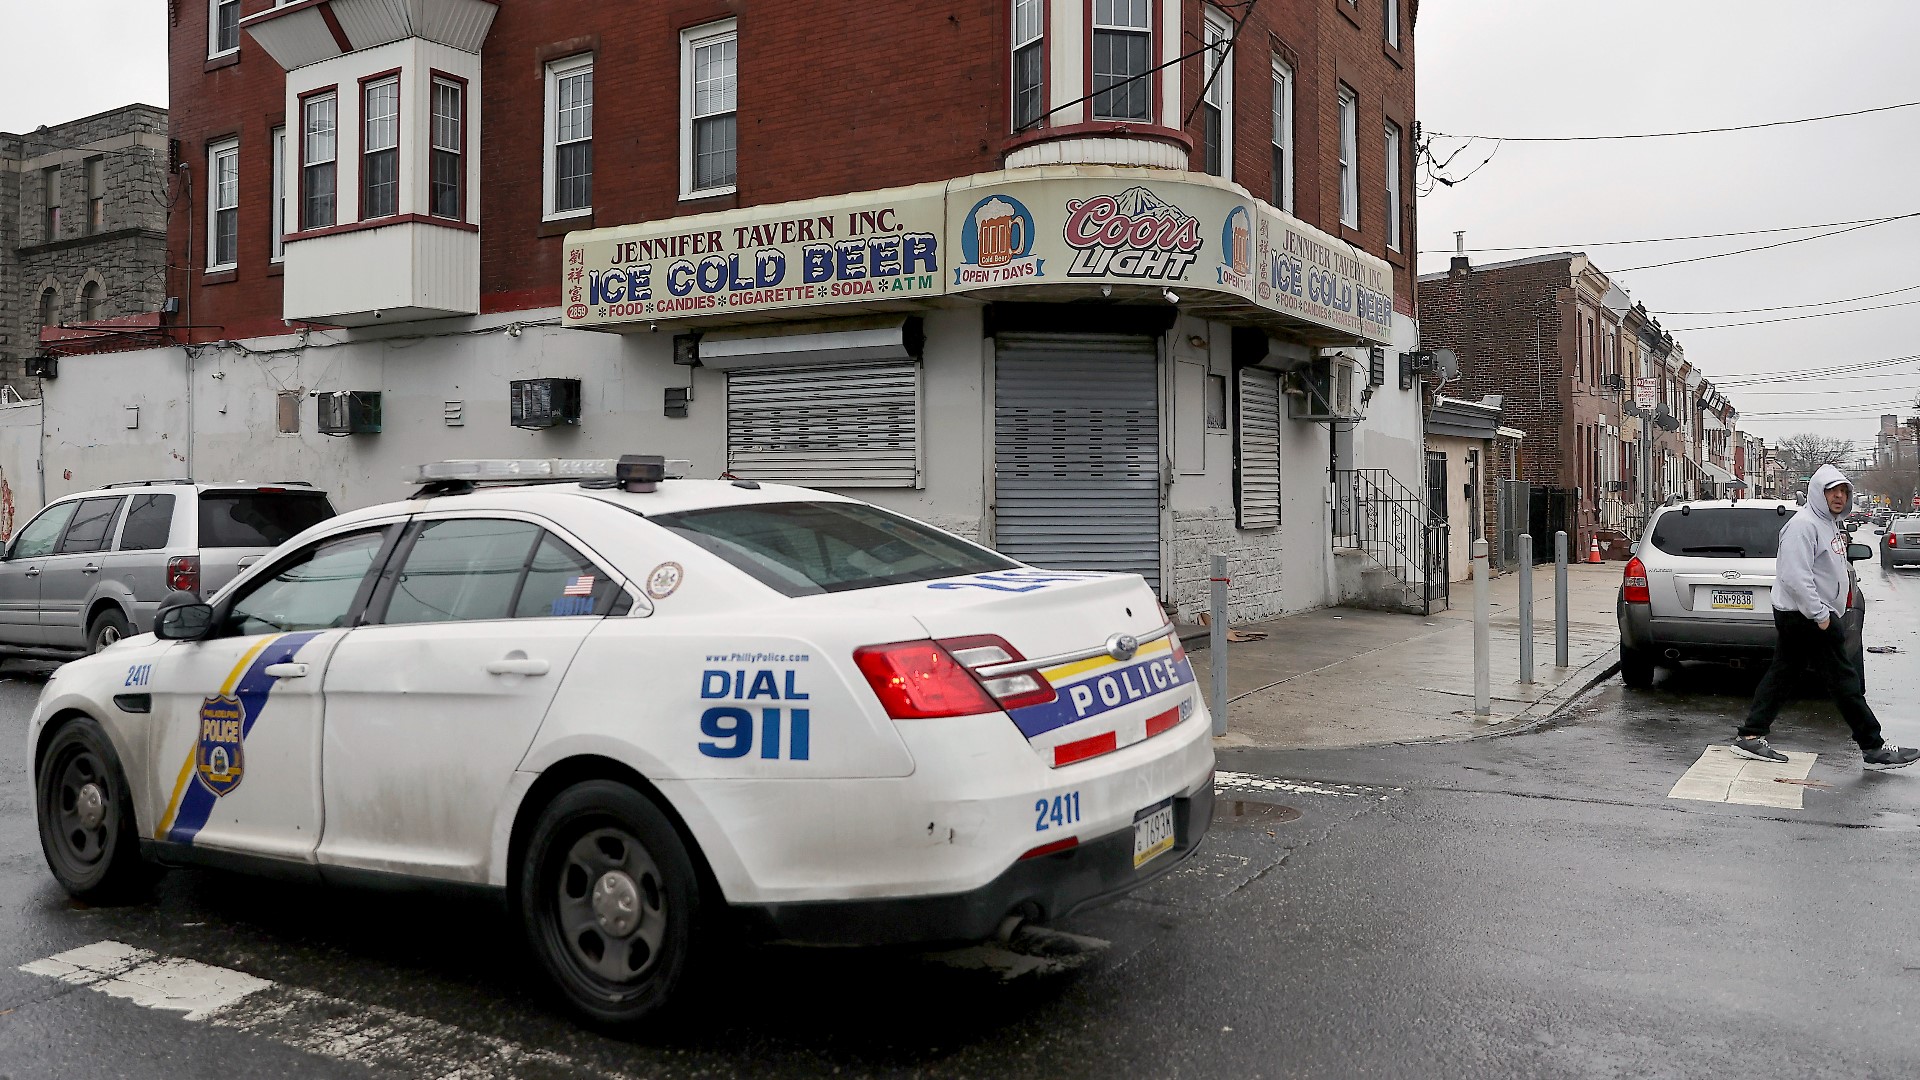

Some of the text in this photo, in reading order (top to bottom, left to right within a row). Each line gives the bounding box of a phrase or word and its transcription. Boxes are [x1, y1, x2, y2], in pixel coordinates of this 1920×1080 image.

[611, 208, 904, 265] JENNIFER TAVERN INC.
[1063, 195, 1204, 253] Coors
[981, 254, 1008, 264] Cold Beer
[1067, 248, 1198, 280] LIGHT
[1283, 229, 1331, 270] JENNIFER
[588, 231, 938, 306] ICE COLD BEER
[962, 262, 1034, 283] OPEN 7 DAYS
[608, 274, 933, 318] FOOD CANDIES CIGARETTE SODA ATM
[1271, 247, 1392, 328] ICE COLD BEER
[568, 305, 587, 319] 2859
[1281, 292, 1298, 310] FOOD
[1303, 300, 1328, 320] CANDIES
[125, 664, 152, 687] 2411
[705, 653, 810, 664] www.PhillyPolice.com
[700, 669, 810, 700] DIAL
[1069, 657, 1180, 718] POLICE
[203, 719, 239, 743] POLICE
[698, 706, 810, 761] 911
[1035, 791, 1081, 832] 2411
